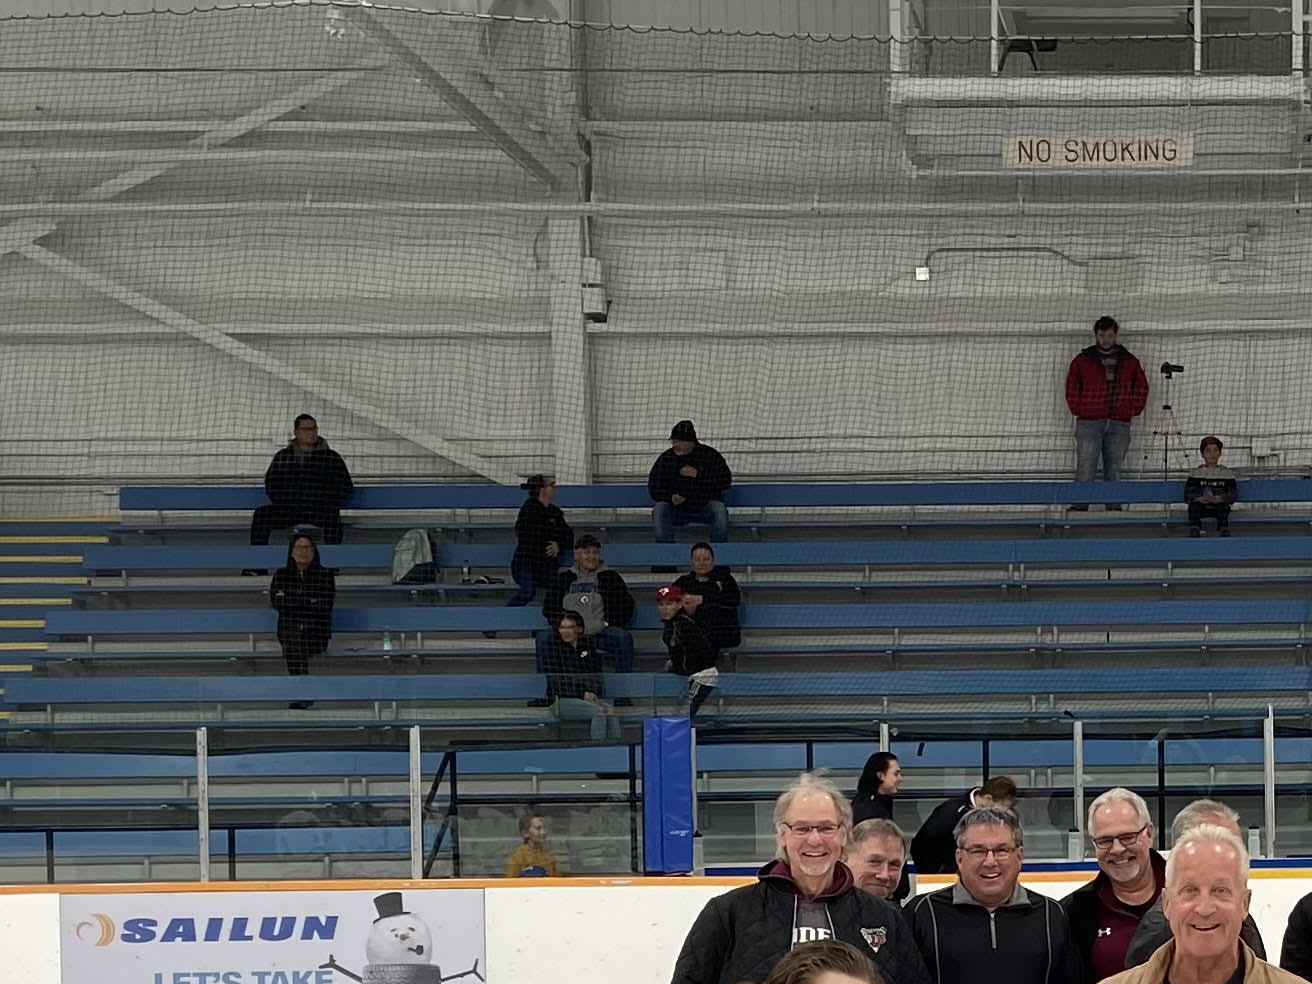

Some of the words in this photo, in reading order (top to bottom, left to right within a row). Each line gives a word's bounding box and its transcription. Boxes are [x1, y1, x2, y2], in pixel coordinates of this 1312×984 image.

[1017, 139, 1051, 163] NO
[1063, 139, 1178, 163] SMOKING
[120, 915, 339, 943] SAILUN
